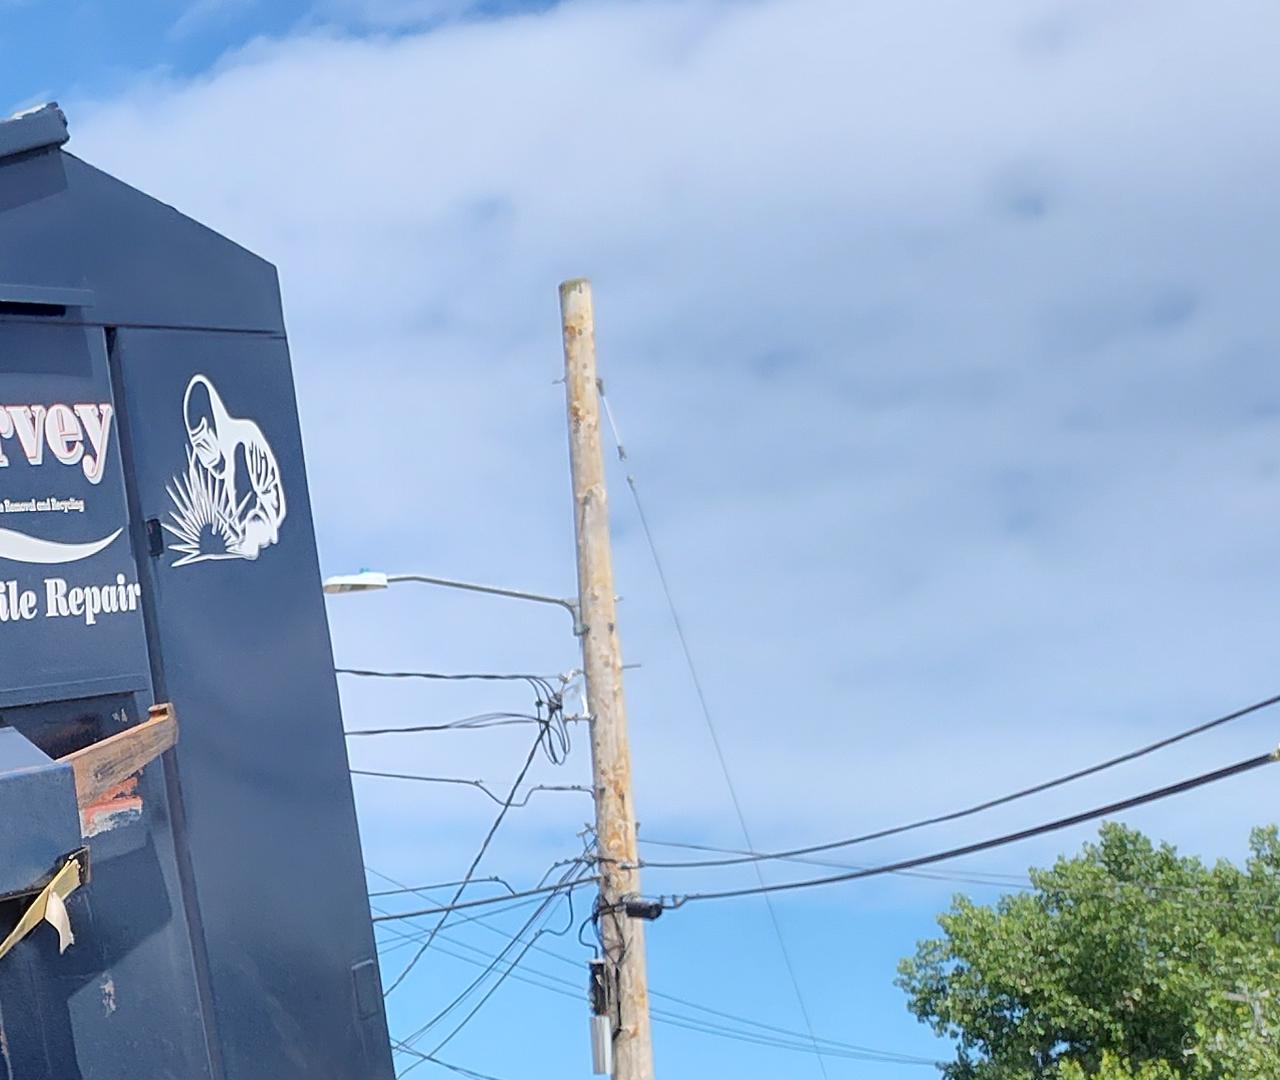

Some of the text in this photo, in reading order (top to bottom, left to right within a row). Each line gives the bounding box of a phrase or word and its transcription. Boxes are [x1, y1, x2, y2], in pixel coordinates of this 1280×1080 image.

[4, 500, 35, 513] Removal
[36, 498, 51, 511] and
[52, 498, 84, 513] Recycling
[44, 573, 141, 627] Repair
